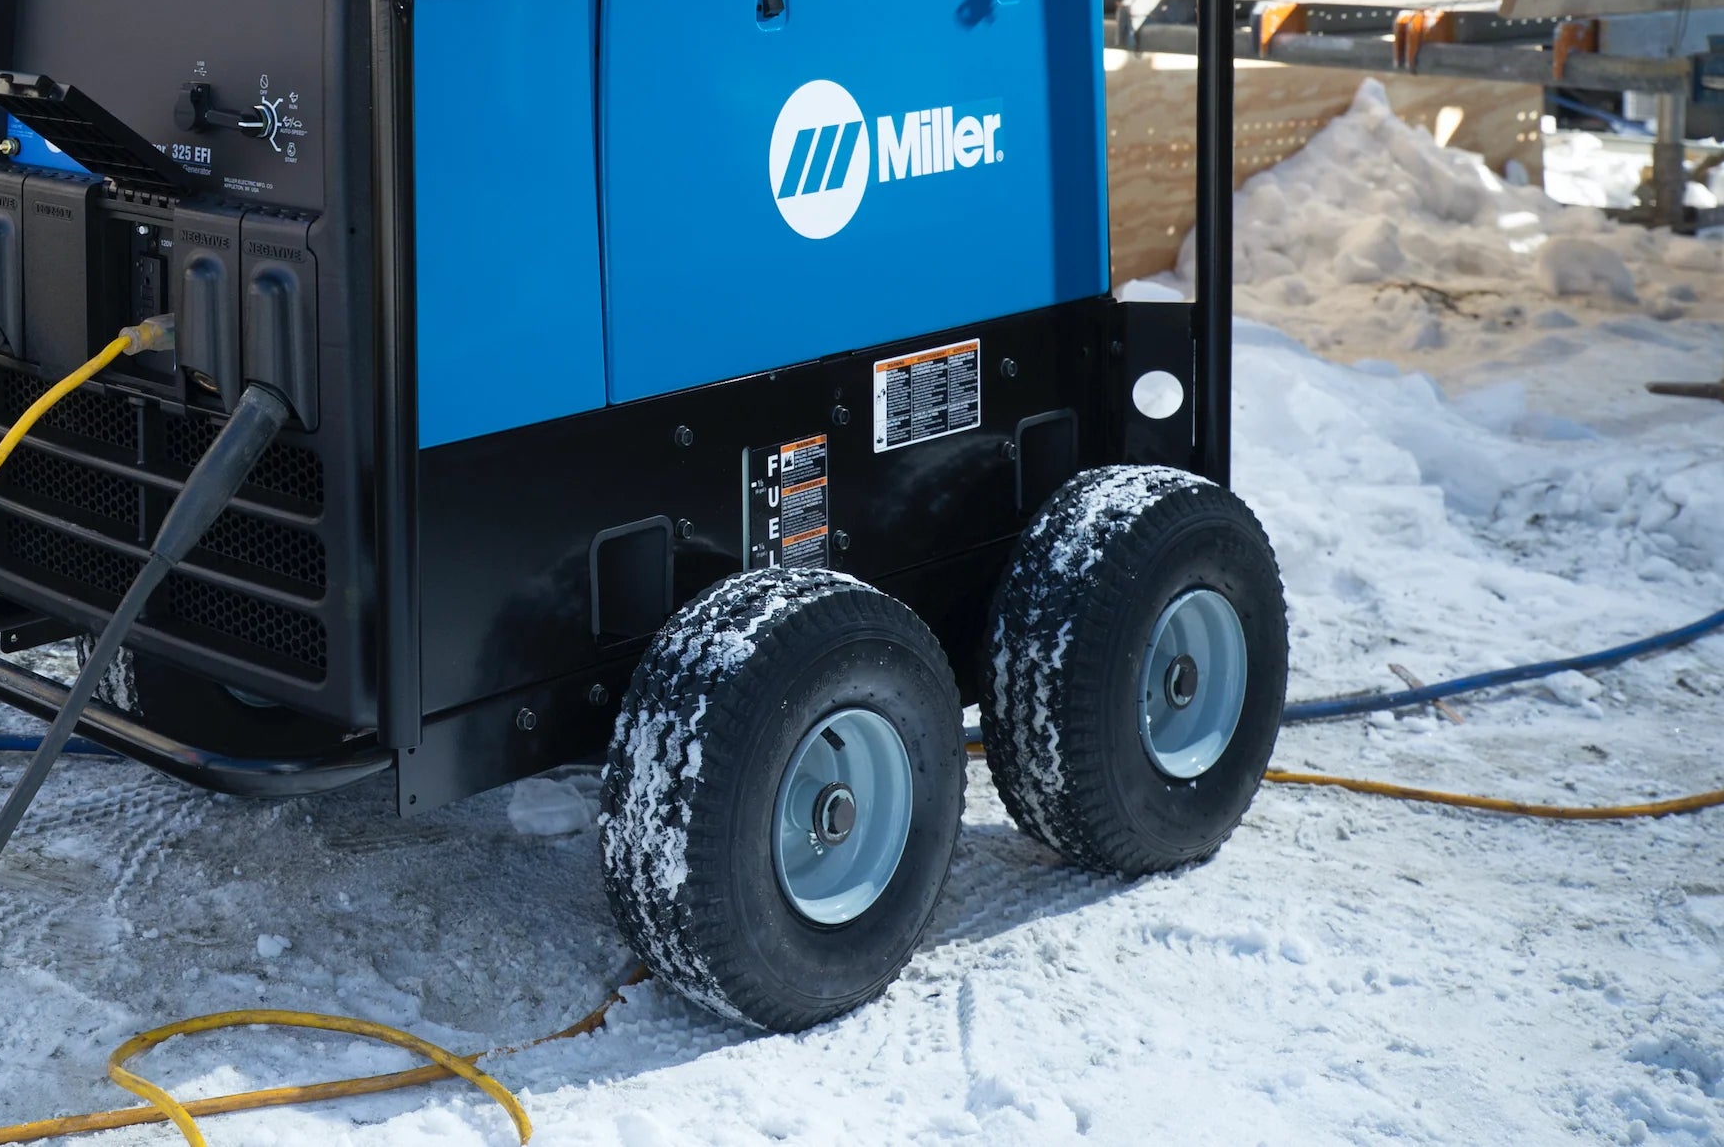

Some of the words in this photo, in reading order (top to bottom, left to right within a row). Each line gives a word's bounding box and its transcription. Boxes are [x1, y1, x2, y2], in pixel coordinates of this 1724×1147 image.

[172, 144, 191, 161] 325
[195, 146, 211, 163] EFI
[182, 164, 212, 175] Generator
[237, 178, 256, 186] ELECTRIC
[179, 230, 230, 249] NEGATIVE
[249, 242, 302, 261] NEGATIVE
[767, 454, 780, 568] FUEL
